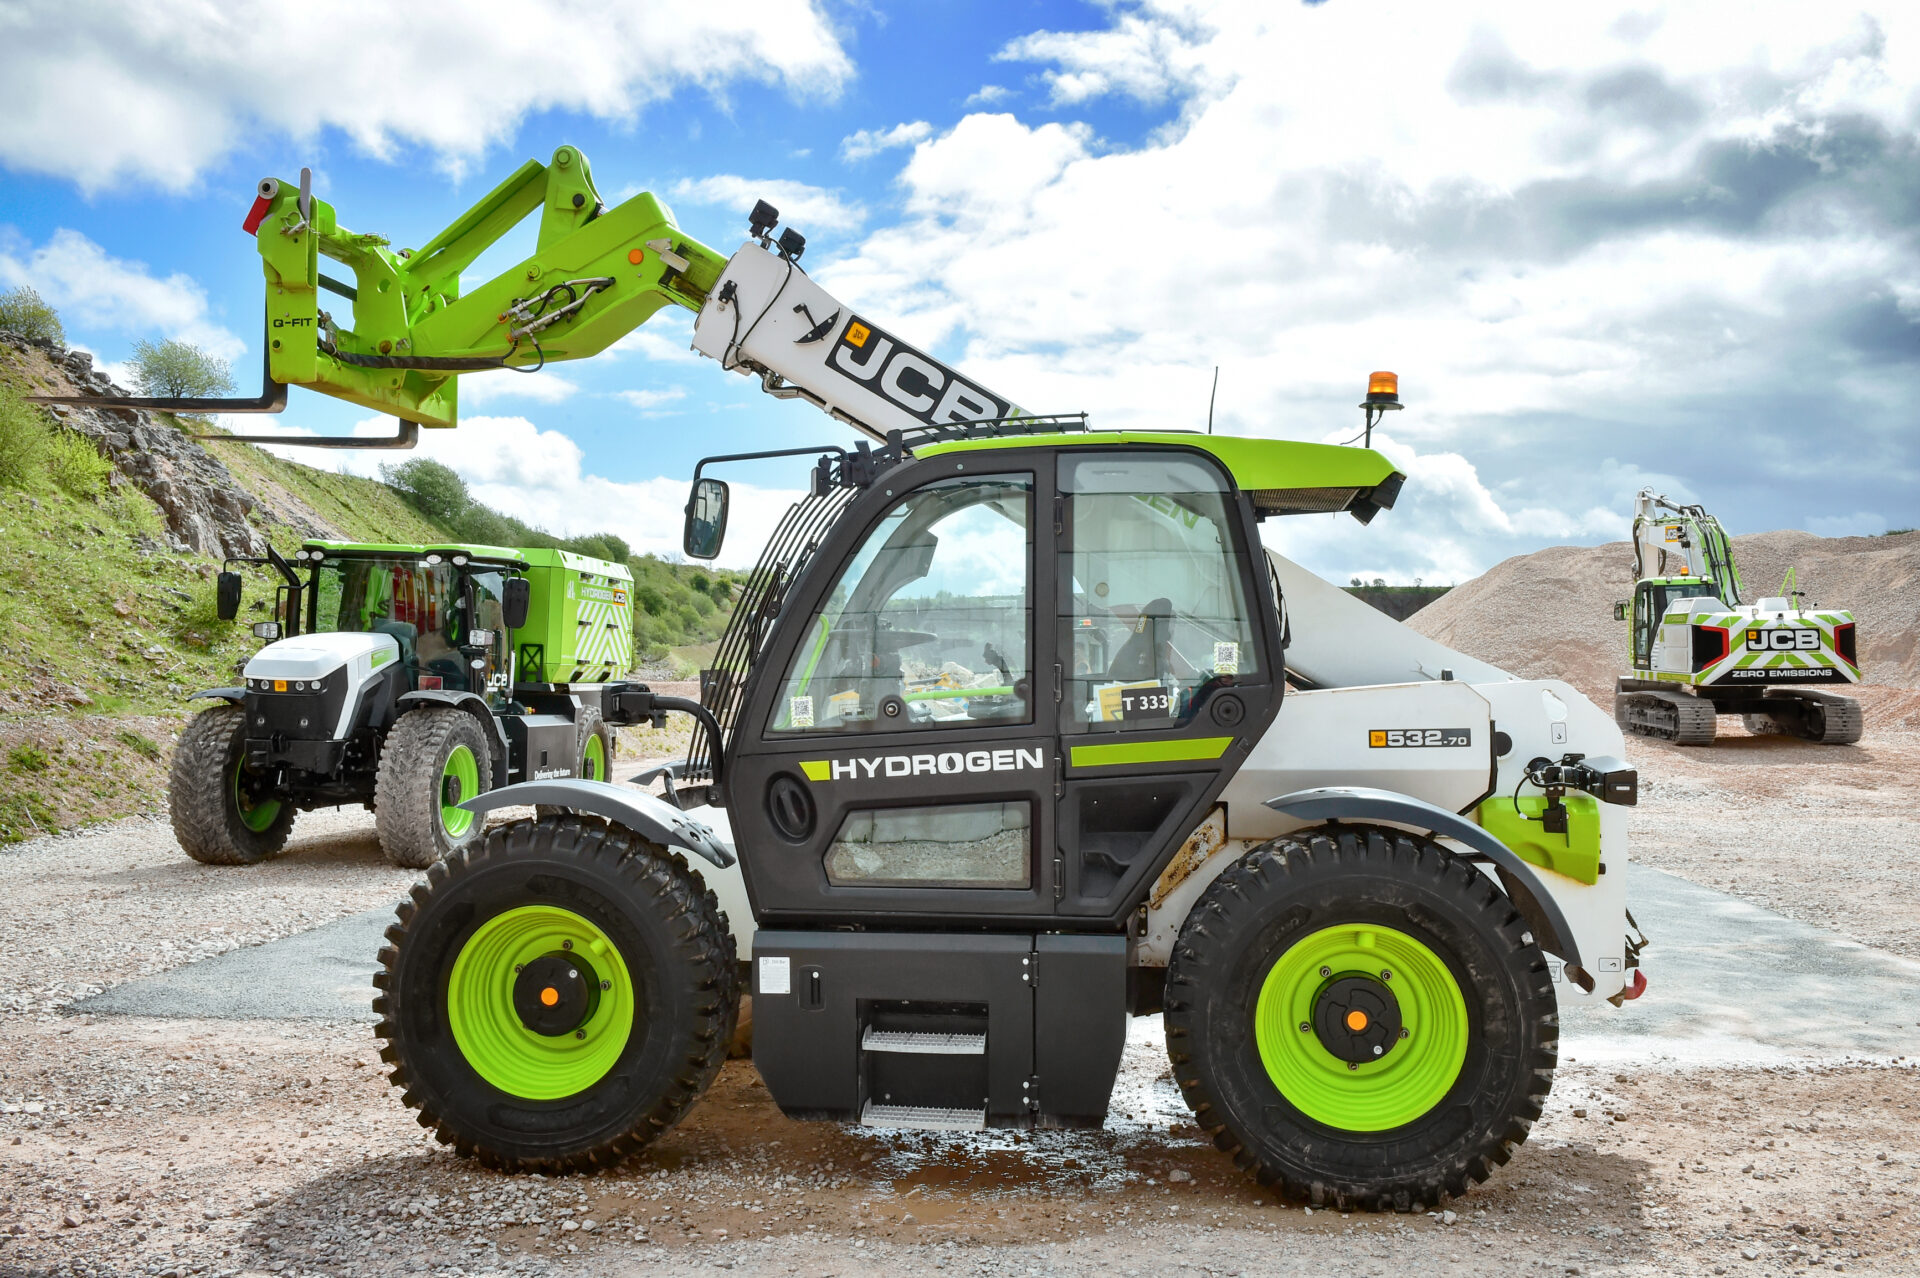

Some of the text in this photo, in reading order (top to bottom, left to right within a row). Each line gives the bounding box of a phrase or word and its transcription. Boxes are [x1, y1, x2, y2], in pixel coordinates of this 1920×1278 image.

[273, 318, 313, 328] Q-FIT
[835, 337, 999, 432] JCB
[1666, 529, 1678, 540] JCB
[1748, 630, 1820, 650] JCB
[487, 673, 508, 686] JCB
[1732, 669, 1832, 678] ZERO EMISSIONS
[1123, 697, 1134, 711] T
[1140, 695, 1168, 710] 333
[1387, 730, 1467, 746] 532-70
[832, 748, 1044, 780] HYDROGEN
[534, 769, 553, 780] Delivering
[560, 767, 571, 777] future
